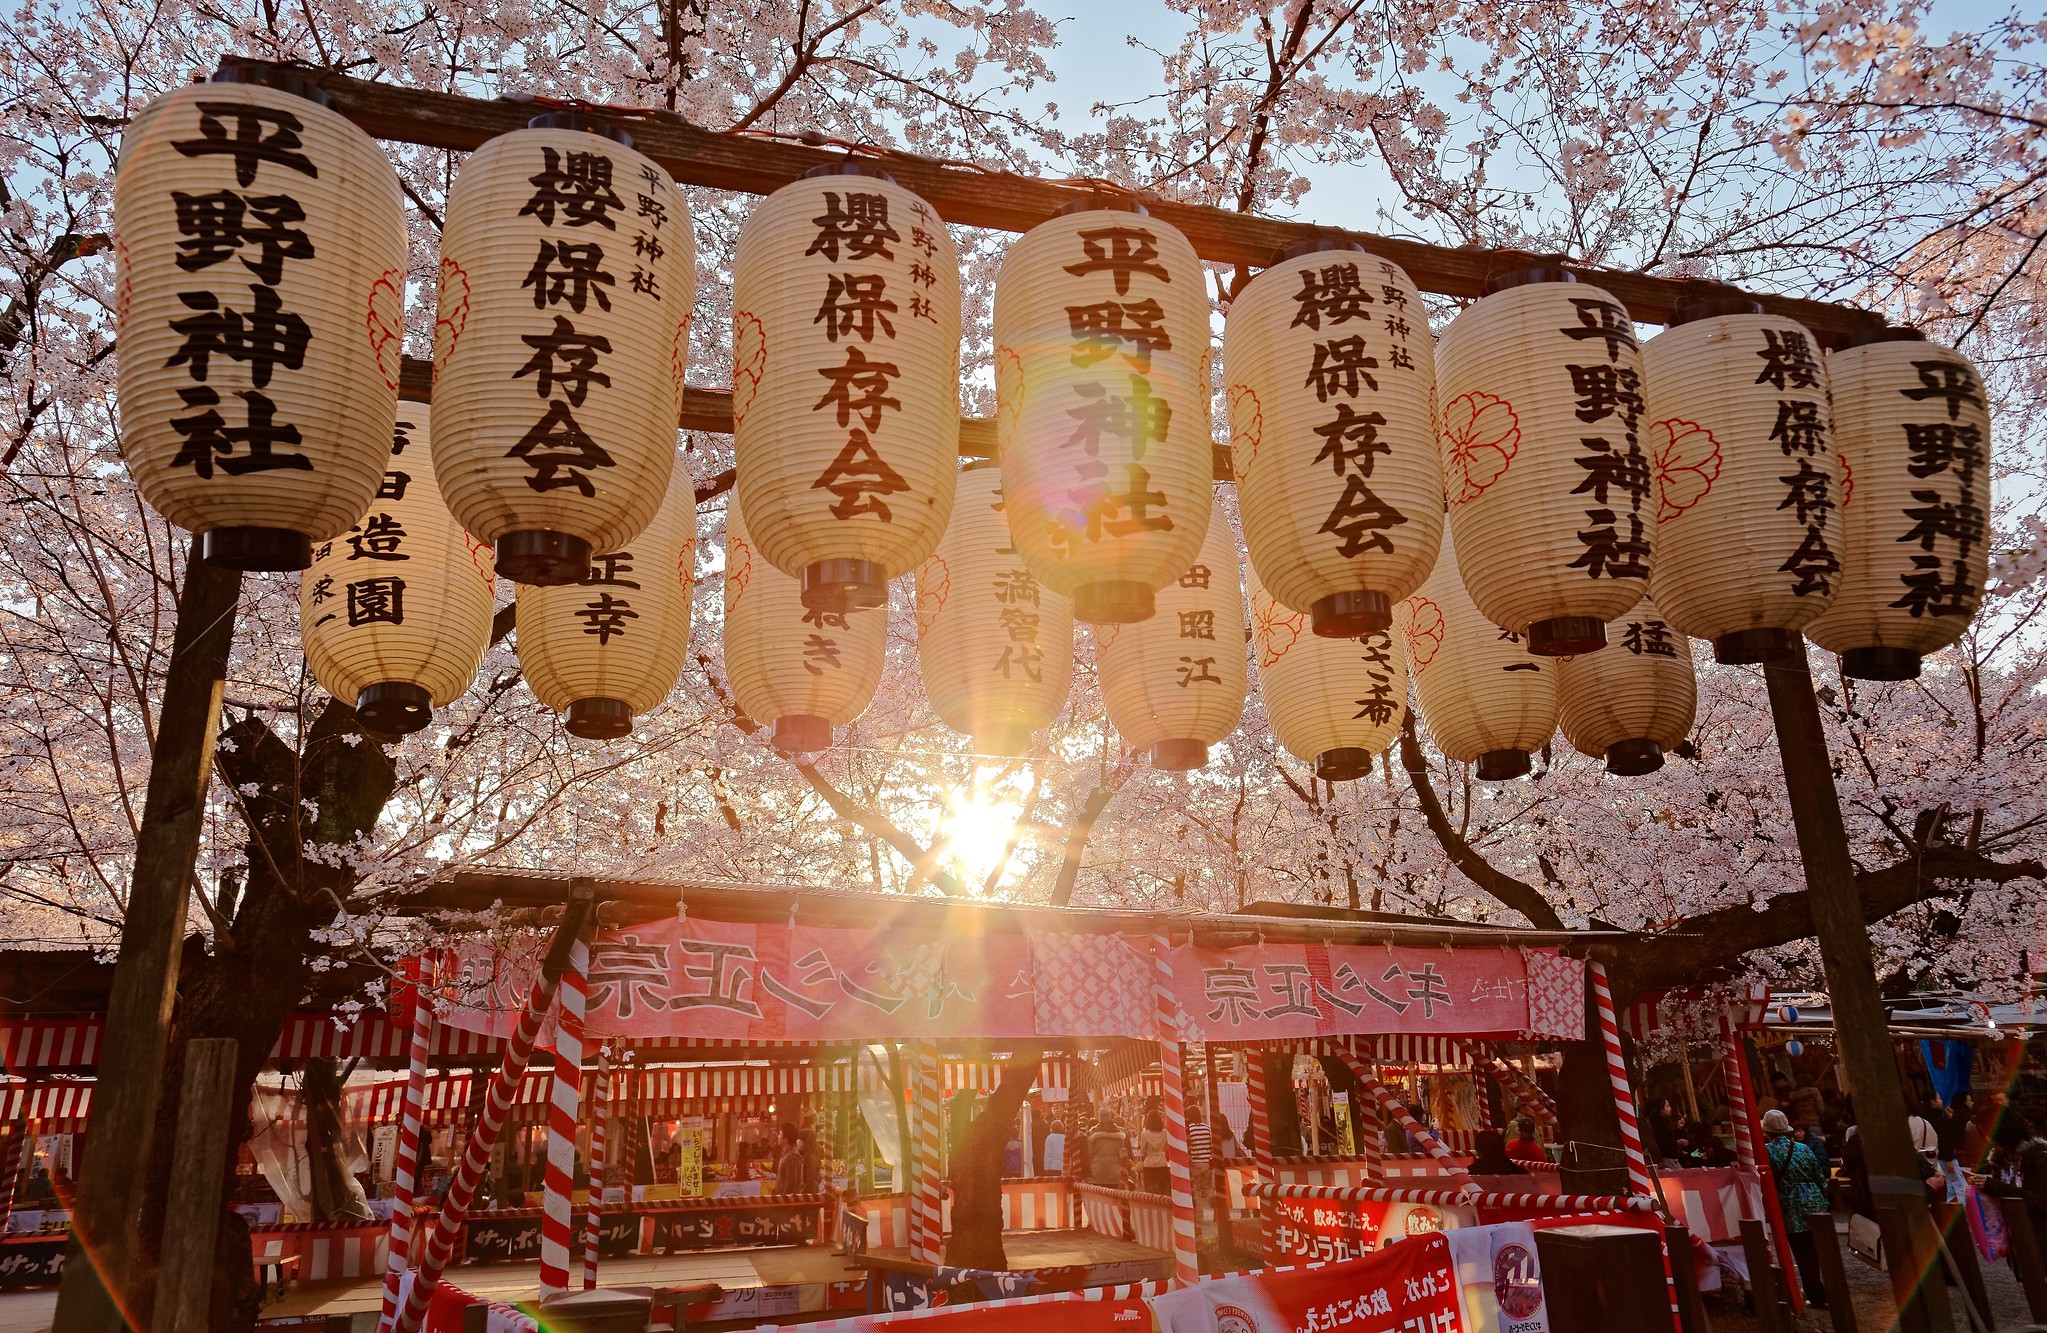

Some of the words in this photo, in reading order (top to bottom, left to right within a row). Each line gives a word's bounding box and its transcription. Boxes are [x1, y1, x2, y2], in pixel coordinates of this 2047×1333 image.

[163, 101, 318, 480] 平野神社
[503, 147, 624, 498] 櫻保存会
[627, 163, 669, 301] 平野神社
[805, 192, 911, 523] 櫻保存会
[909, 202, 938, 325] 平野神社
[1378, 262, 1415, 371] 平野神社
[1059, 227, 1174, 542] 平野神社
[1290, 263, 1408, 559] 櫻保存会
[1559, 298, 1651, 579] 平野神社
[1755, 329, 1841, 597] 櫻保存会
[1888, 360, 1985, 618] 平野神社
[474, 1223, 633, 1251] サッポビール
